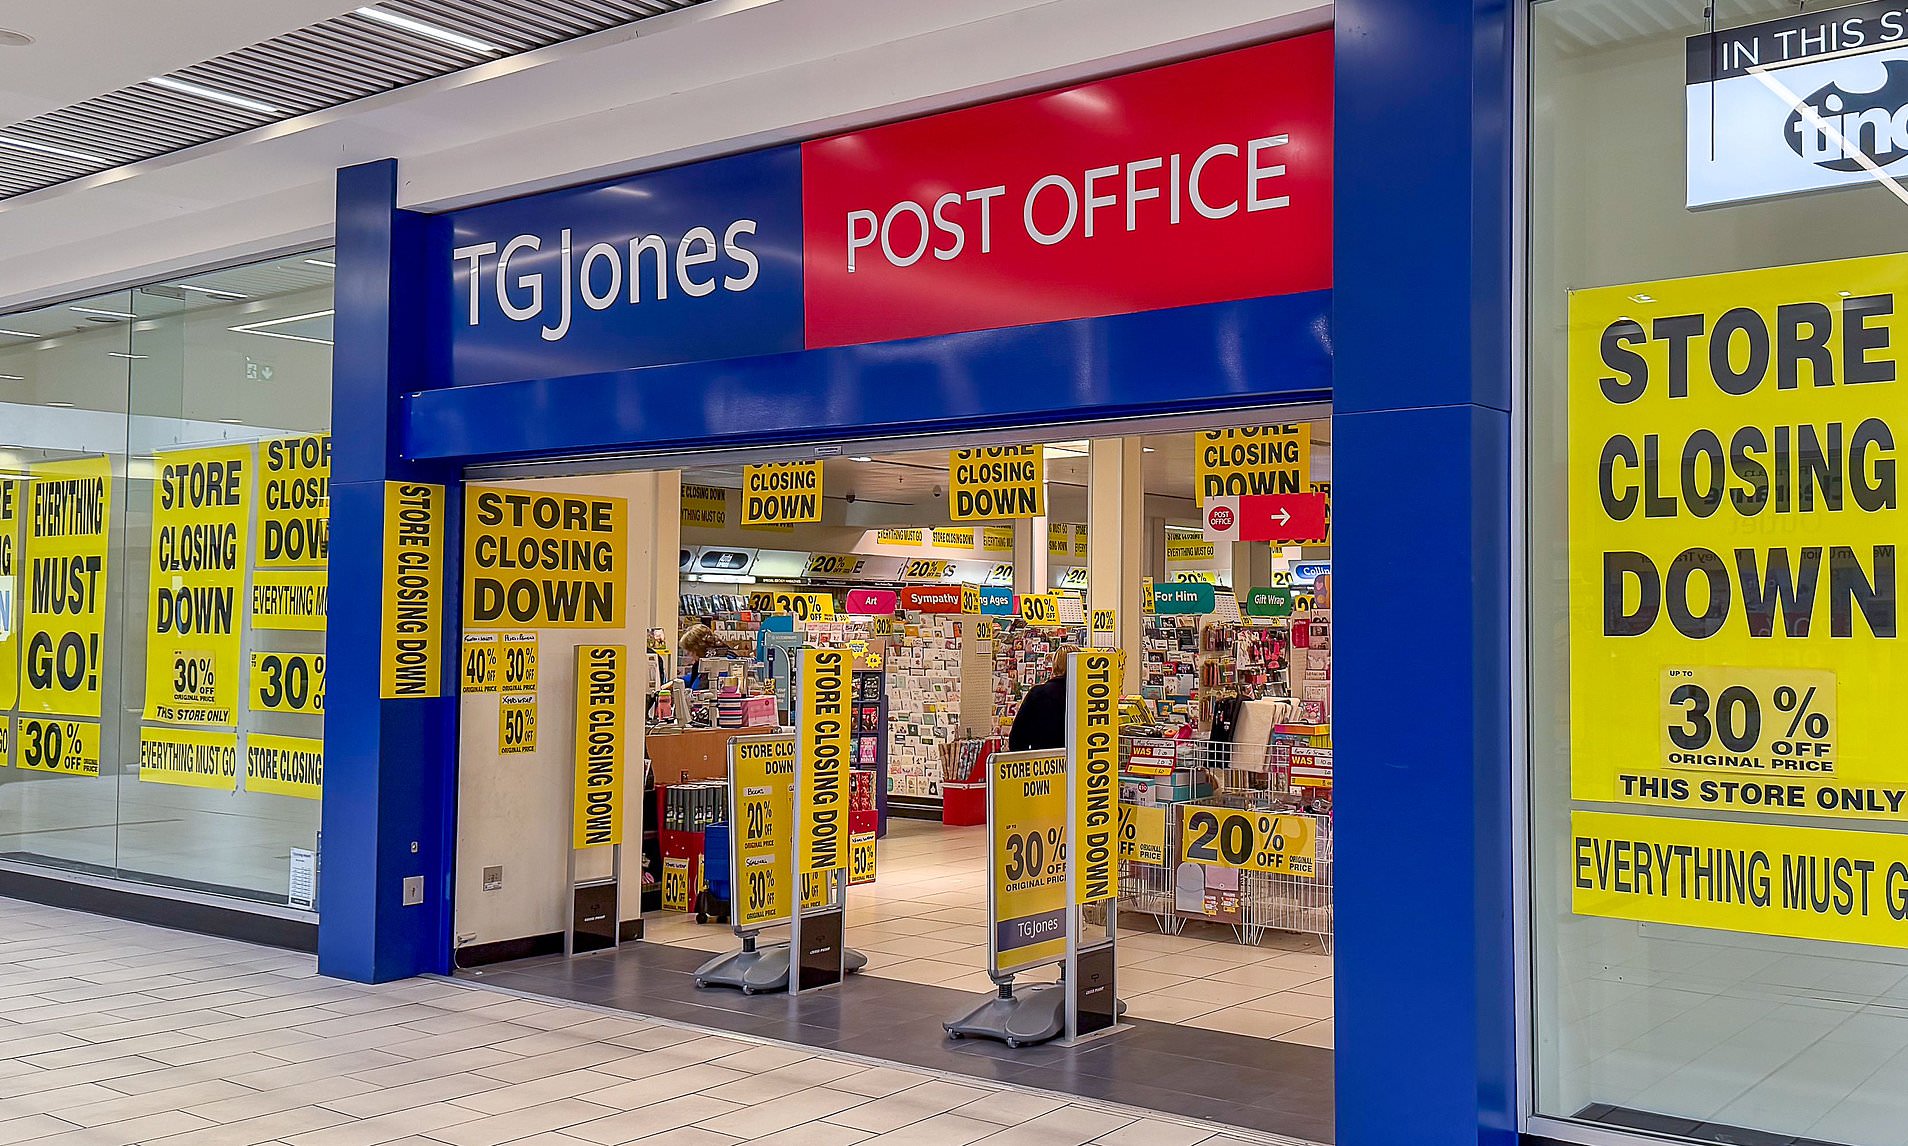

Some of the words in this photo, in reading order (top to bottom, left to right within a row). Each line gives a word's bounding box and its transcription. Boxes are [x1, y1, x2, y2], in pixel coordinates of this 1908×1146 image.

[1723, 37, 1759, 71] IN
[1773, 18, 1865, 60] THIS
[1879, 9, 1908, 41] S
[846, 184, 1006, 273] POST
[1023, 133, 1291, 246] OFFICE
[453, 219, 760, 341] TGJones
[1598, 293, 1897, 405] STORE
[1203, 441, 1299, 468] CLOSING
[750, 470, 816, 492] CLOSING
[956, 461, 1035, 484] CLOSING
[1203, 469, 1300, 497] DOWN
[1598, 417, 1897, 522] CLOSING
[161, 460, 242, 510] STORE
[686, 486, 708, 499] CLOSING
[709, 488, 725, 500] DOWN
[34, 476, 104, 537] EVERYTHING
[477, 492, 613, 532] STORE
[749, 494, 816, 520] DOWN
[957, 487, 1037, 516] DOWN
[398, 485, 431, 547] STORE
[701, 510, 715, 522] MUST
[716, 512, 725, 523] GO
[159, 523, 236, 571] CLOSING
[474, 534, 613, 572] CLOSING
[32, 555, 102, 614] MUST
[396, 551, 430, 633] CLOSING
[1155, 591, 1172, 601] For
[1175, 591, 1197, 602] Him
[1602, 544, 1897, 640] DOWN
[157, 587, 234, 635] DOWN
[252, 585, 314, 616] EVERYTHING
[473, 577, 613, 622] DOWN
[865, 596, 877, 605] Art
[911, 593, 959, 605] Sympathy
[989, 595, 1009, 606] Ages
[1254, 594, 1267, 605] Gift
[1268, 595, 1285, 606] Wrap
[810, 613, 822, 621] OFF
[27, 631, 99, 691] GO!
[394, 639, 427, 695] DOWN
[525, 669, 534, 680] OFF
[487, 670, 496, 681] OFF
[590, 648, 616, 705] STORE
[815, 653, 842, 715] STORE
[200, 687, 215, 695] OFF
[1086, 656, 1110, 727] STORE
[177, 709, 205, 721] STORE
[207, 710, 229, 722] ONLY
[525, 731, 534, 741] OFF
[587, 710, 615, 787] CLOSING
[1771, 741, 1832, 757] OFF
[64, 756, 82, 771] OFF
[141, 741, 194, 772] EVERYTHING
[195, 745, 221, 775] MUST
[222, 748, 236, 776] GO
[740, 744, 773, 759] STORE
[813, 720, 841, 805] CLOSING
[1133, 747, 1152, 755] WAS
[1291, 756, 1313, 765] WAS
[1668, 753, 1765, 769] ORIGINAL
[1771, 759, 1833, 772] PRICE
[247, 746, 278, 779] STORE
[279, 751, 322, 786] CLOSING
[765, 760, 793, 774] DOWN
[1000, 762, 1031, 779] STORE
[1033, 758, 1066, 776] CLOSIN
[1023, 780, 1050, 797] DOWN
[1086, 733, 1110, 828] CLOSING
[1619, 774, 1690, 801] THIS
[1699, 780, 1806, 808] STORE
[1816, 787, 1907, 813] ONLY
[585, 791, 612, 845] DOWN
[765, 823, 773, 836] OFF
[811, 809, 838, 868] DOWN
[1140, 843, 1161, 852] ORIGINAL
[1085, 832, 1109, 898] DOWN
[1140, 851, 1161, 861] PRICE
[1257, 851, 1284, 868] OFF
[1289, 854, 1313, 864] ORIGINAL
[1289, 863, 1313, 873] PRICE
[1005, 879, 1045, 892] ORIGINAL
[1046, 875, 1066, 885] PRIC
[1575, 836, 1771, 908] EVERYTHING
[1782, 853, 1876, 917] MUST
[765, 909, 776, 917] PRICE
[1017, 917, 1058, 938] TGJones
